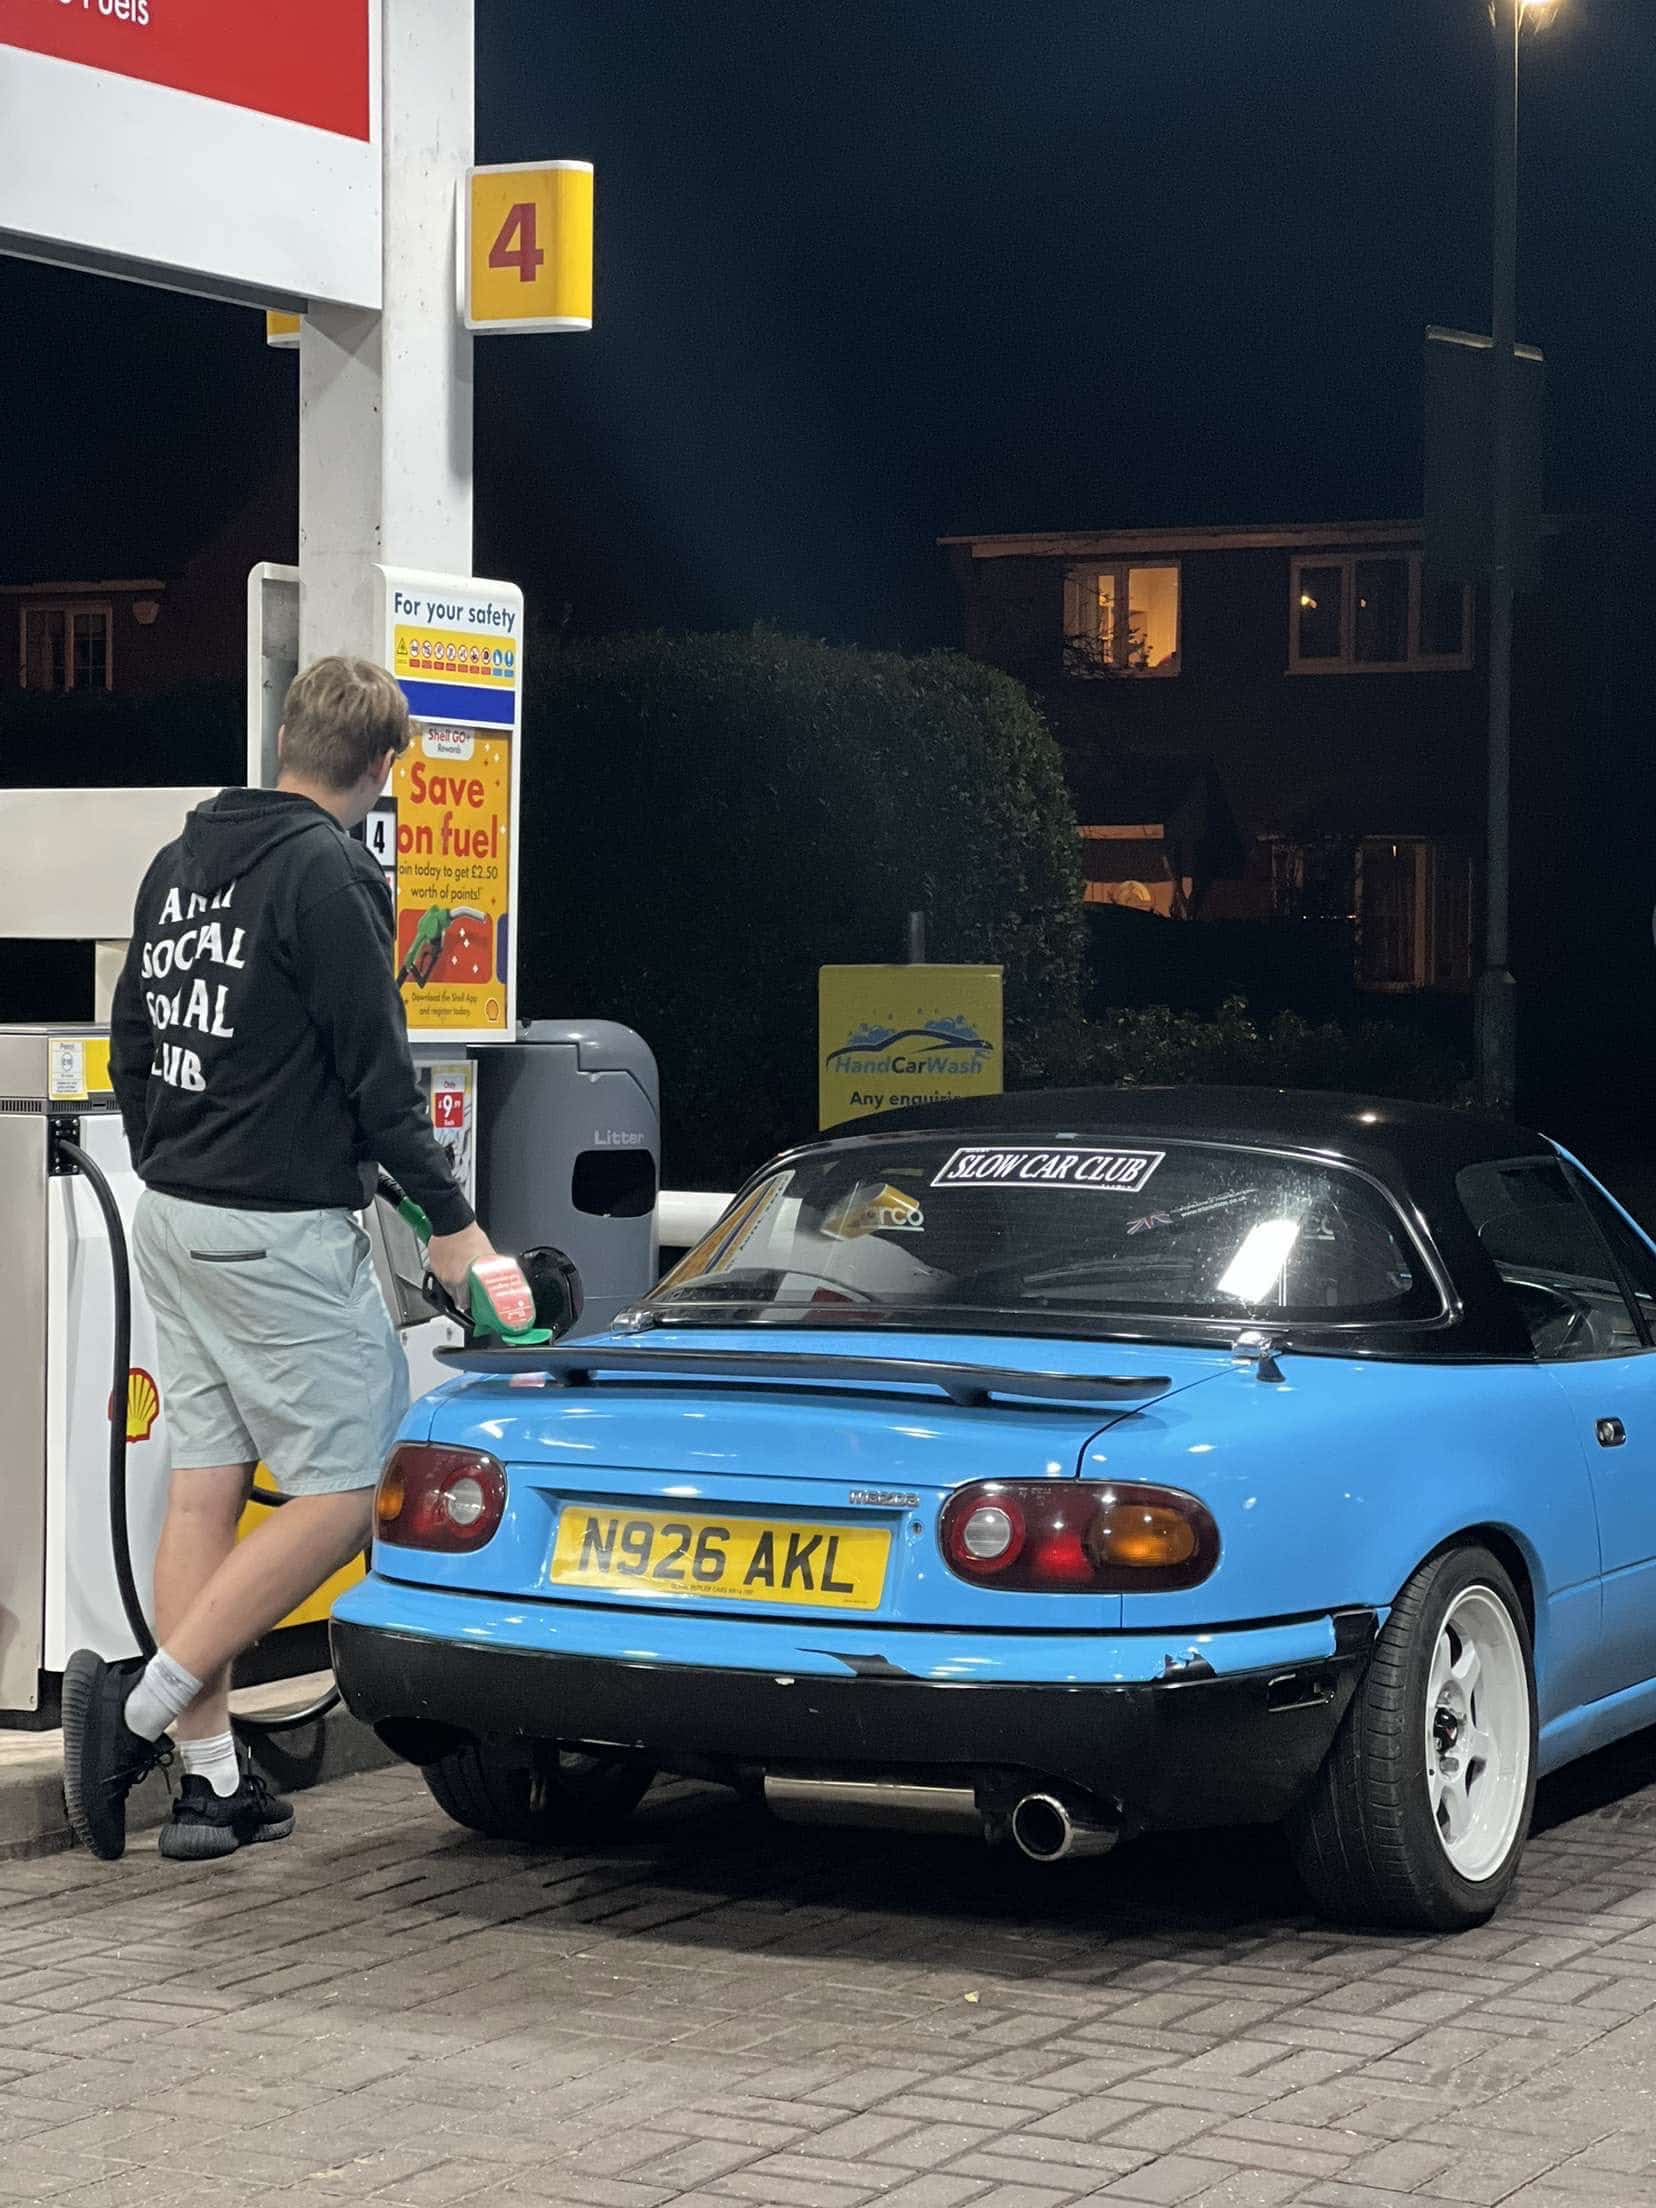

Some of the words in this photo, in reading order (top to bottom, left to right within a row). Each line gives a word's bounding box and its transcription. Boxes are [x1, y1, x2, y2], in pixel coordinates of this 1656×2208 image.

[488, 202, 544, 282] 4
[394, 592, 420, 616] For
[427, 602, 463, 623] your
[468, 603, 515, 633] safety
[428, 728, 449, 742] Shell
[410, 761, 485, 808] Save
[373, 821, 385, 853] 4
[398, 824, 433, 854] on
[441, 810, 498, 858] fuel
[399, 861, 412, 874] oin
[414, 861, 440, 880] today
[443, 865, 453, 877] to
[454, 867, 469, 881] get
[471, 864, 498, 879] £2.50
[411, 884, 437, 898] worth
[439, 884, 450, 899] of
[834, 1056, 982, 1074] HandCarWash
[849, 1091, 883, 1109] Any
[594, 1129, 645, 1145] Litter
[947, 1154, 1028, 1179] SLOW
[1019, 1154, 1079, 1180] CAR
[1074, 1156, 1148, 1183] CLUB
[578, 1517, 731, 1583] N926
[743, 1530, 854, 1594] AKL
